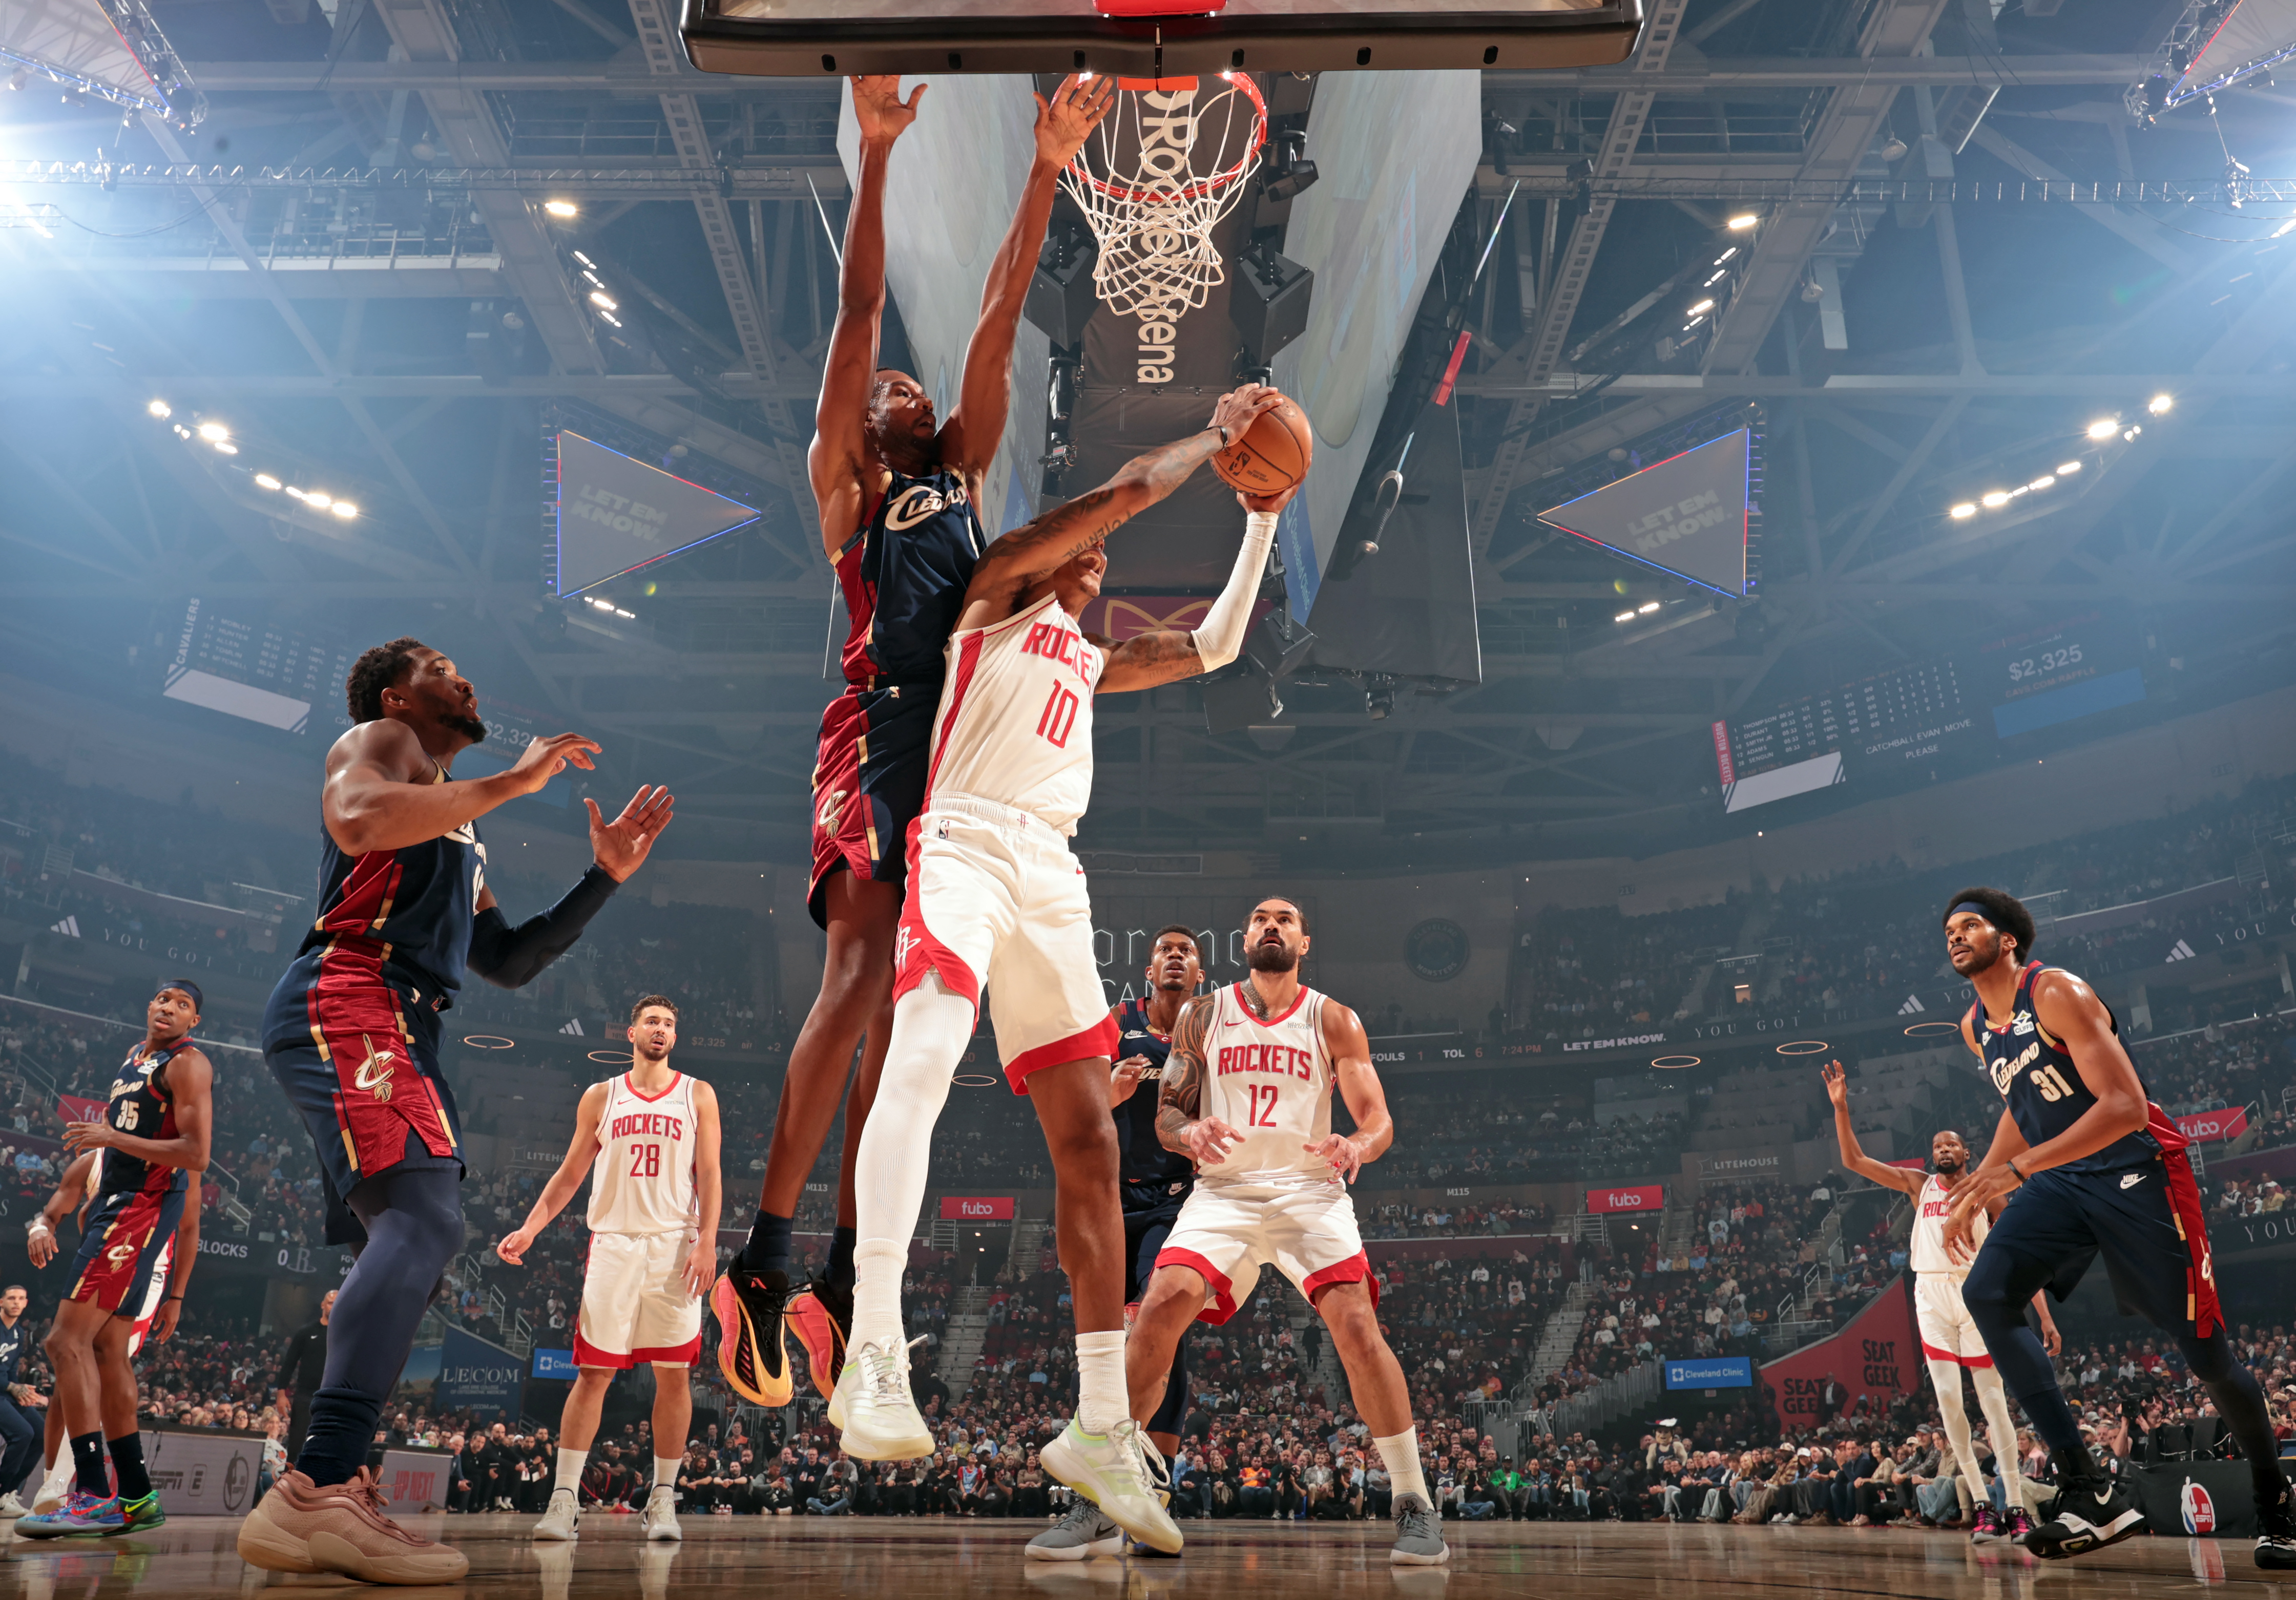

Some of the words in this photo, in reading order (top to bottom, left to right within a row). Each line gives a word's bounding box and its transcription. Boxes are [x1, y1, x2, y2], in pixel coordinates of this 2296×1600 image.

[1137, 280, 1188, 383] Arena
[579, 483, 628, 512] LET
[633, 502, 668, 525] EM
[1627, 511, 1677, 536] LET
[1681, 490, 1719, 515] EM
[176, 597, 200, 665] CAVALIERS
[216, 637, 239, 648] ALLEN
[2009, 644, 2082, 682] $2,325
[1036, 679, 1078, 748] 10
[1743, 716, 1777, 730] THOMPSON
[484, 720, 537, 747] $2,32
[1715, 722, 1726, 751] HOUSTON
[1744, 727, 1768, 739] DURANT
[1866, 736, 1914, 754] CATCHBALL
[1917, 727, 1940, 741] EVAN
[1746, 738, 1764, 747] SMITH
[1747, 745, 1767, 755] ADAMS
[1906, 744, 1939, 759] PLEASE
[1748, 752, 1773, 764] SENGUN
[1720, 753, 1732, 783] ROCKETS
[2216, 922, 2266, 944] YOU
[103, 928, 149, 951] YOU
[168, 947, 212, 967] GOT
[1415, 961, 1458, 977] MONSTERS
[1944, 988, 1971, 1003] YO
[1695, 1023, 1737, 1039] YOU
[1757, 1016, 1798, 1031] GOT
[2015, 1023, 2033, 1034] CLIFFS
[691, 1037, 725, 1047] $2,325
[767, 1042, 781, 1052] +2
[1501, 1046, 1522, 1056] 7:24
[1525, 1045, 1541, 1054] PM
[1563, 1042, 1591, 1051] LET
[1593, 1039, 1615, 1049] EM
[1617, 1033, 1666, 1047] KNOW.
[1370, 1051, 1405, 1062] FOULS
[1418, 1051, 1424, 1060] 1
[1443, 1049, 1465, 1059] TOL
[1475, 1047, 1483, 1058] 6
[1218, 1044, 1311, 1081] ROCKETS
[1990, 1041, 2040, 1096] CLEVELAND
[2030, 1064, 2075, 1102] 31
[85, 1105, 102, 1123] fu
[115, 1099, 140, 1130] 35
[1249, 1084, 1278, 1127] 12
[612, 1113, 682, 1141] ROCKETS
[2180, 1120, 2219, 1138] fubo
[526, 1152, 566, 1163] LITEHO
[630, 1144, 660, 1177] 28
[1715, 1156, 1779, 1170] LITEHOUSE
[2123, 1173, 2139, 1183] NIKE
[805, 1183, 828, 1192] M113
[1447, 1188, 1470, 1196] M115
[962, 1202, 993, 1215] fubo
[1608, 1193, 1641, 1208] fubo
[2244, 1216, 2296, 1243] YOU
[198, 1238, 248, 1259] BLOCKS
[277, 1249, 288, 1266] 0
[1862, 1339, 1895, 1363] SEAT
[1685, 1370, 1721, 1378] Cleveland
[1722, 1368, 1744, 1377] Clinic
[1863, 1365, 1902, 1388] GEEK
[1783, 1378, 1826, 1396] SEAT
[1783, 1397, 1818, 1415] GEE
[150, 1470, 184, 1490] ESPN
[393, 1470, 410, 1501] UP
[409, 1471, 435, 1501] NEXT
[2201, 1503, 2210, 1513] NBA
[2195, 1514, 2211, 1523] ESPN
